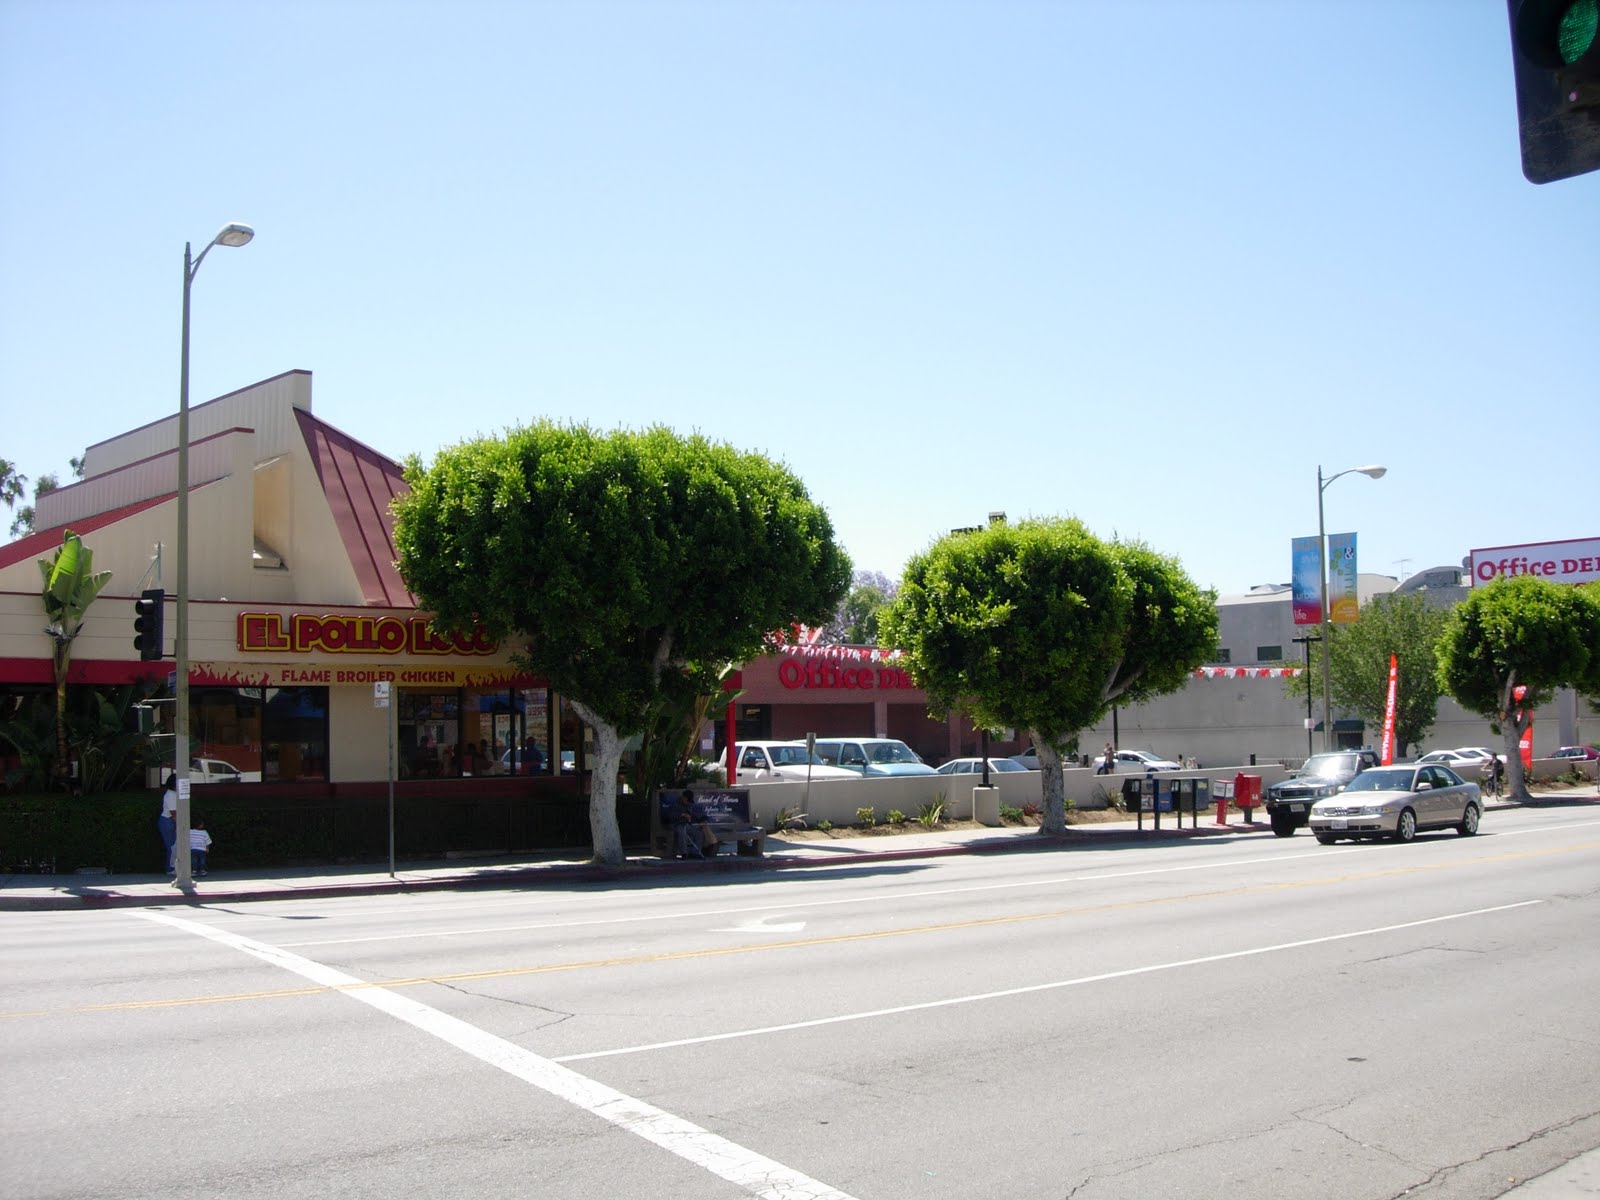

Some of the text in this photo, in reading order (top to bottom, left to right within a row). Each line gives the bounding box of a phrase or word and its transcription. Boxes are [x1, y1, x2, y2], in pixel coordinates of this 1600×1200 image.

[1477, 557, 1557, 581] Office
[1294, 609, 1307, 620] life
[241, 612, 291, 650] EL
[293, 615, 407, 653] POLLO
[281, 669, 455, 683] FLAME BROILED CHICKEN
[778, 658, 913, 689] Office DE
